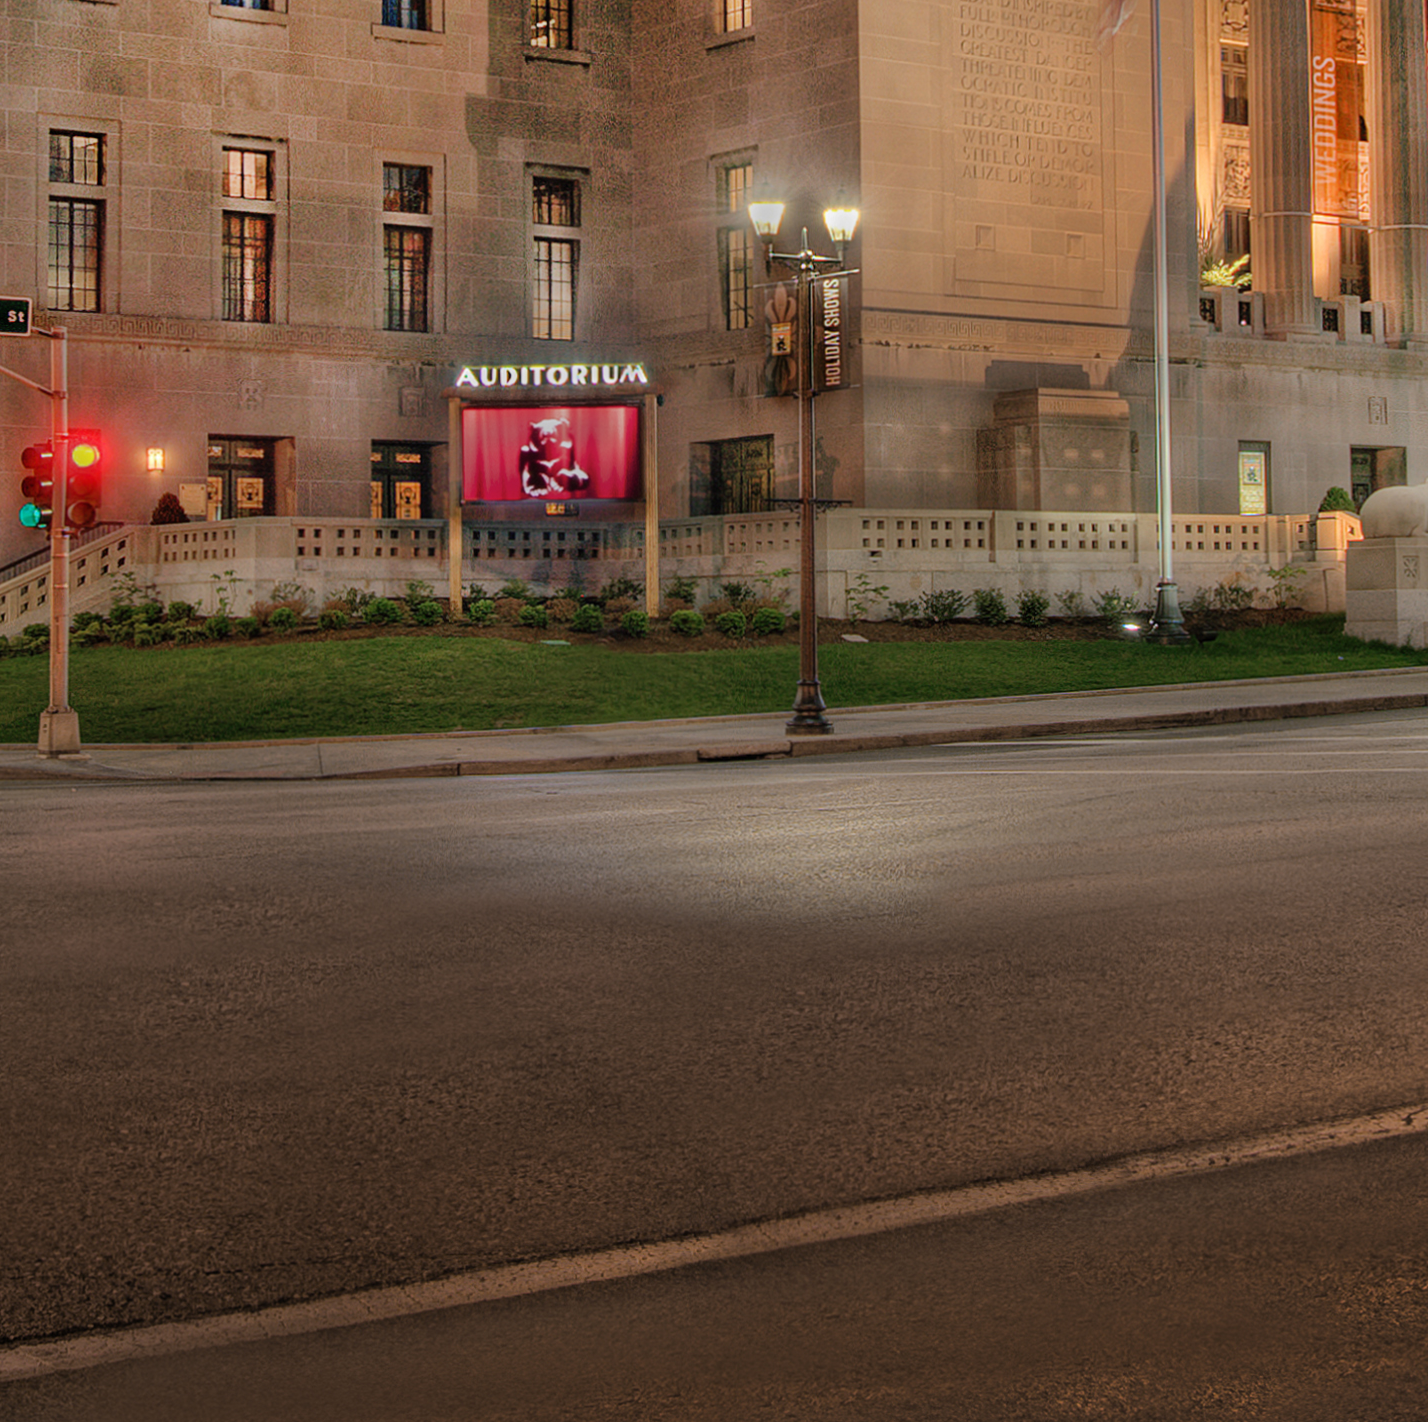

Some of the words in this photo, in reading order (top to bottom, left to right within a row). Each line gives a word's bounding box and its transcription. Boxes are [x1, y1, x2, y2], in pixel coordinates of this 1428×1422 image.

[960, 39, 1029, 63] GREATEST
[961, 75, 1027, 98] OCRATIC
[962, 110, 1010, 130] THOSE
[1004, 98, 1052, 118] COMES
[1056, 105, 1093, 124] FROM
[1313, 56, 1337, 184] WEDDINGS
[963, 129, 1019, 149] WHICH
[1072, 141, 1092, 158] TO
[963, 146, 1011, 166] STIFLE
[962, 165, 1004, 183] ALIZE
[1008, 168, 1093, 192] DISCUSSION
[823, 278, 841, 327] SHOWS
[7, 309, 25, 323] St
[824, 330, 841, 386] HOLIDAY
[456, 364, 648, 387] AUDITORIUM
